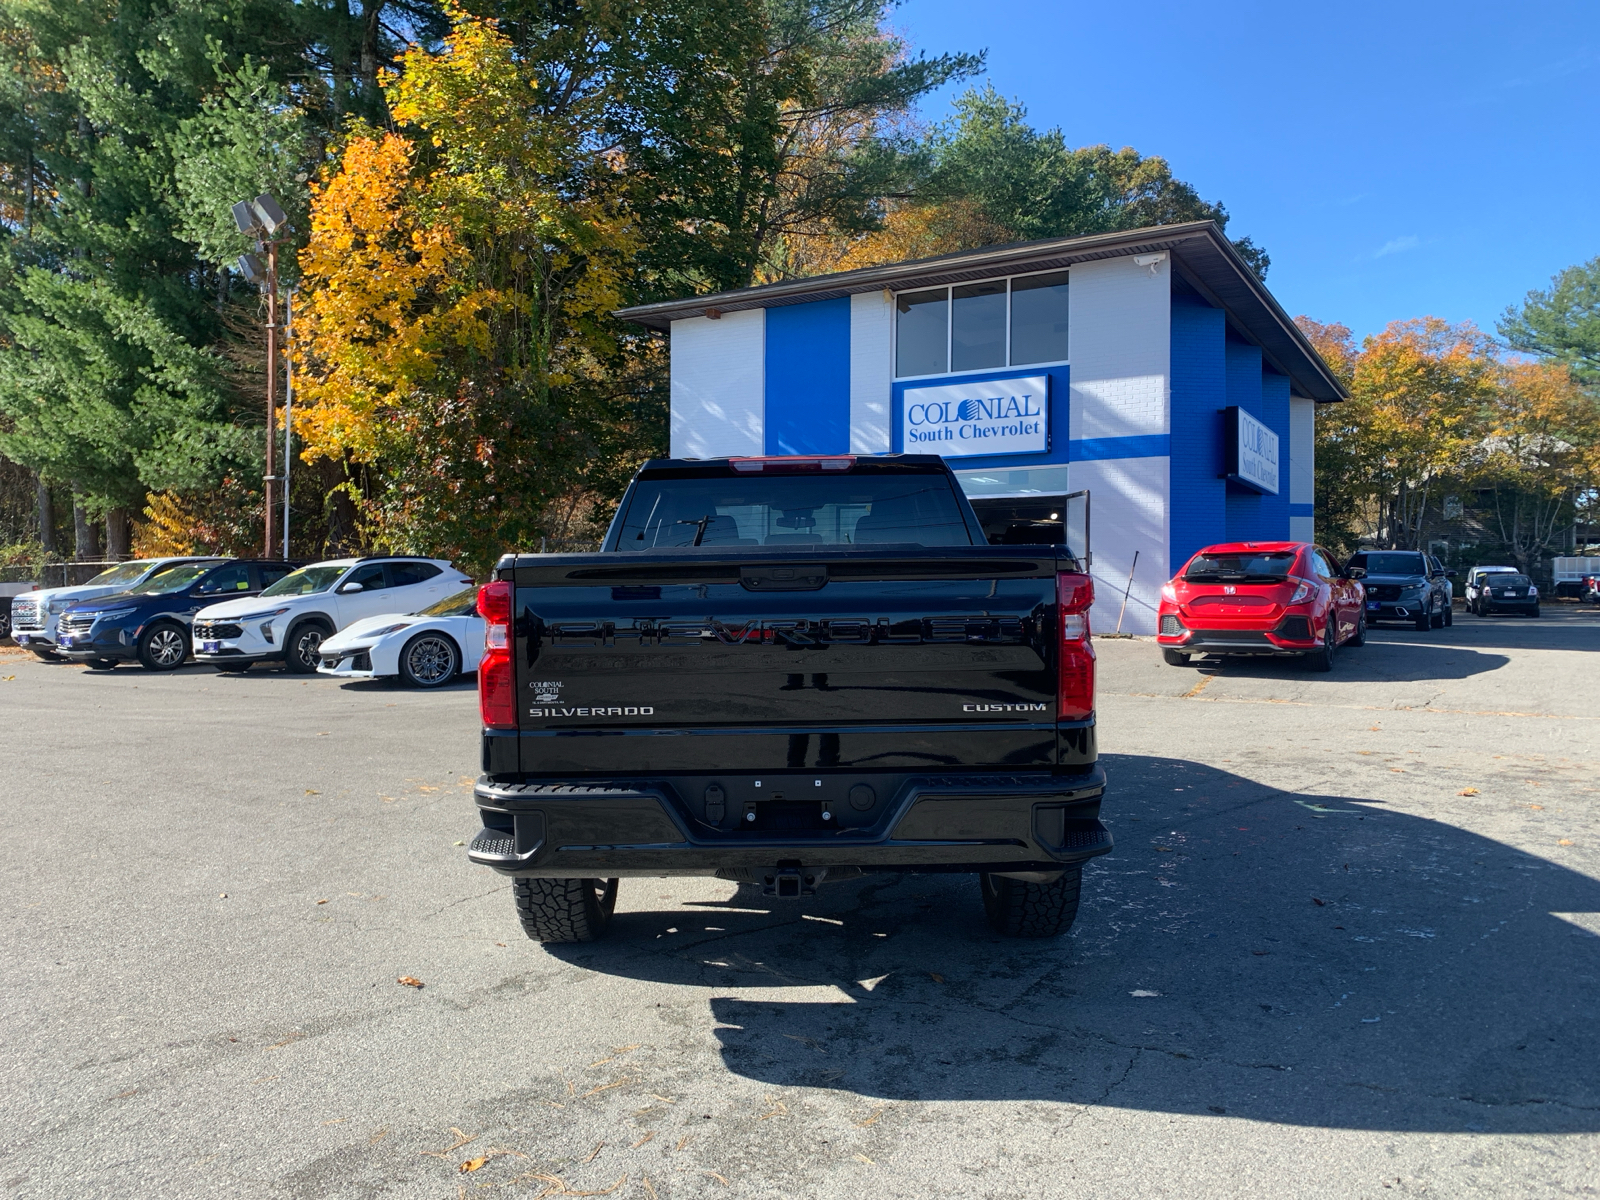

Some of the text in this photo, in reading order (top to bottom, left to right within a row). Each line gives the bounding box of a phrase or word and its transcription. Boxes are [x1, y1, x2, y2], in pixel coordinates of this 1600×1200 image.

[908, 395, 1041, 426] COLONIAL
[909, 420, 1040, 443] South Chevrolet
[551, 615, 1022, 649] CHEVROLET
[529, 681, 564, 689] COLONIAL
[529, 706, 654, 717] SILVERADO
[962, 703, 1047, 712] CUSTOM
